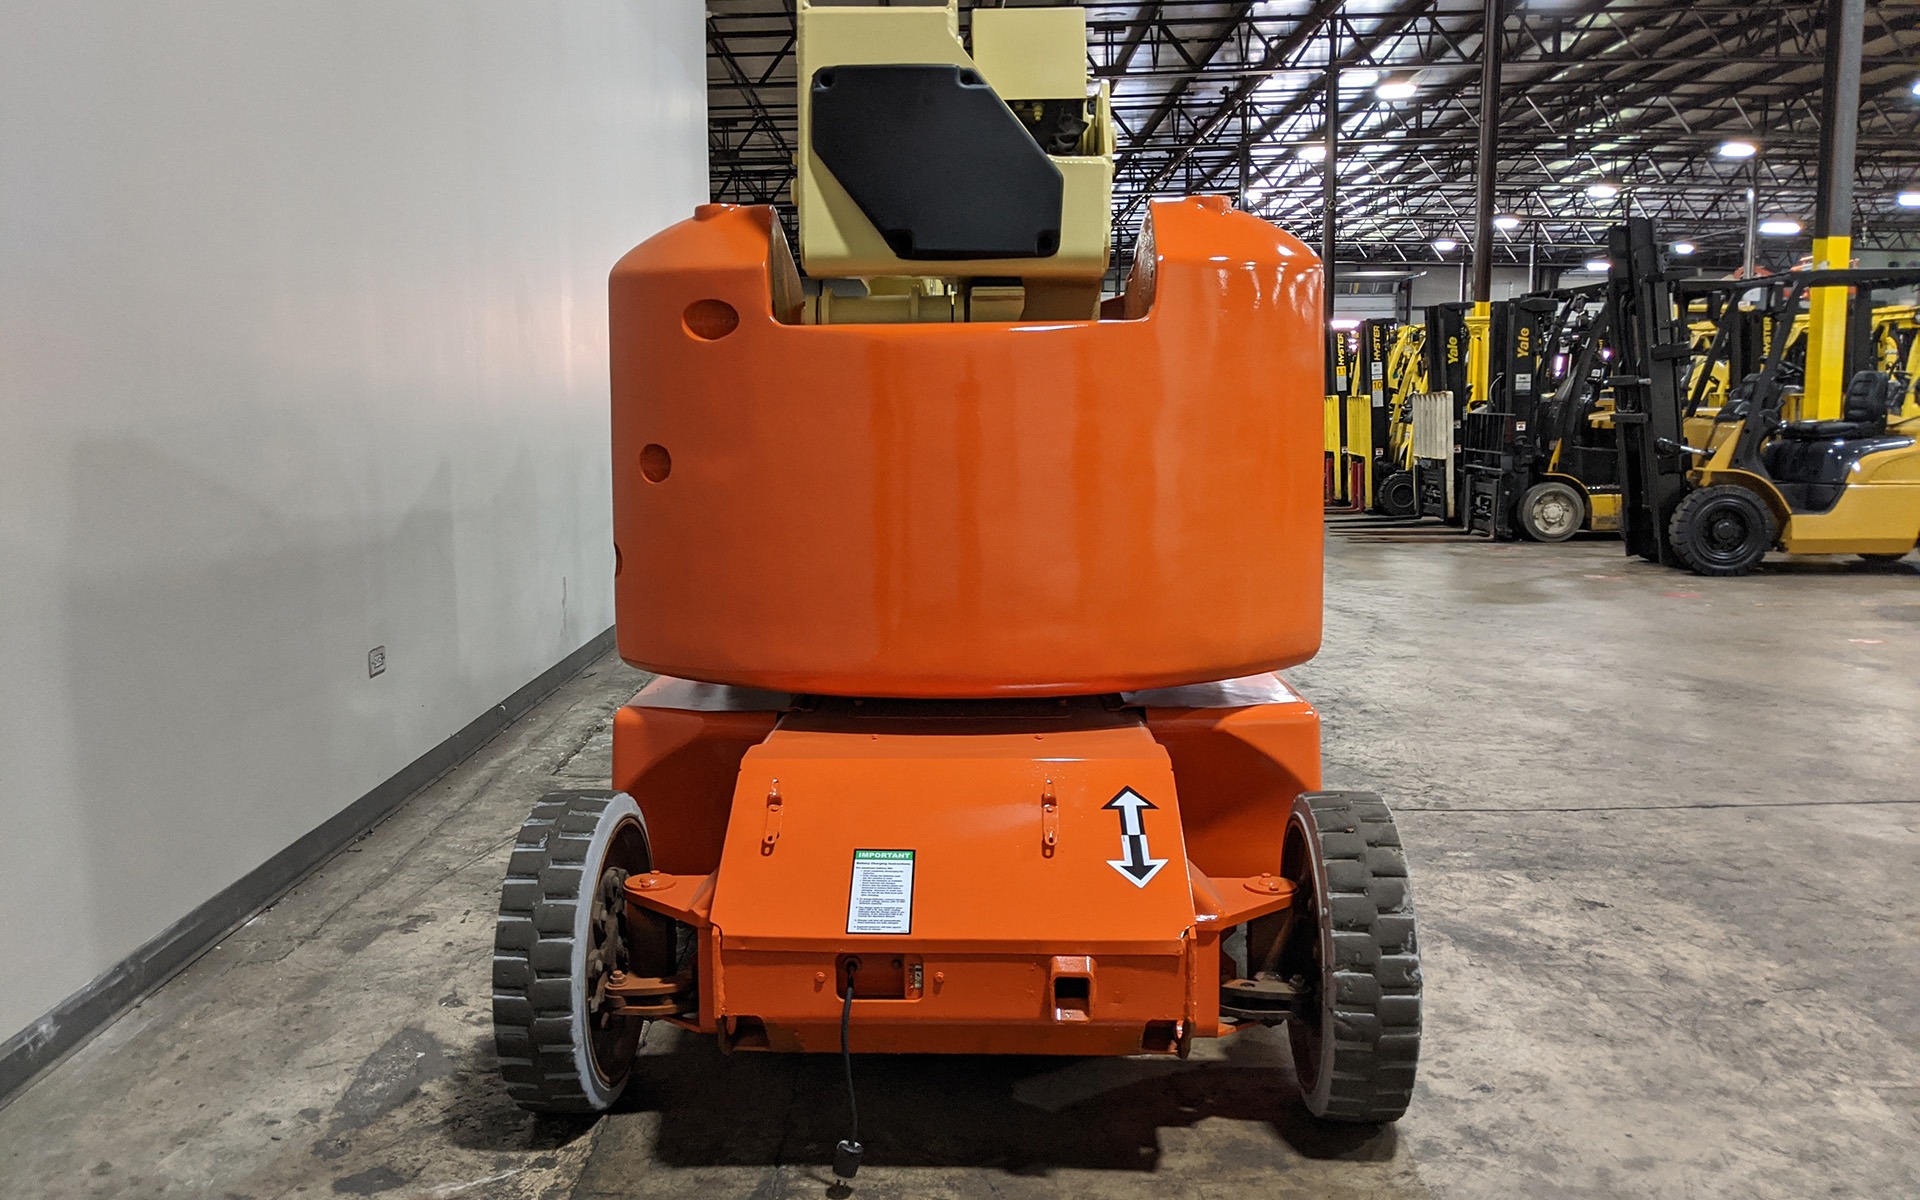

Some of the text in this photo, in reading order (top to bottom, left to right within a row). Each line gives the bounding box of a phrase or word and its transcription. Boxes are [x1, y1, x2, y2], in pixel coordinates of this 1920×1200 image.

[1337, 332, 1345, 366] HYSTER
[1373, 325, 1381, 361] HYSTER
[1447, 336, 1459, 364] Yale
[1517, 327, 1530, 358] Yale
